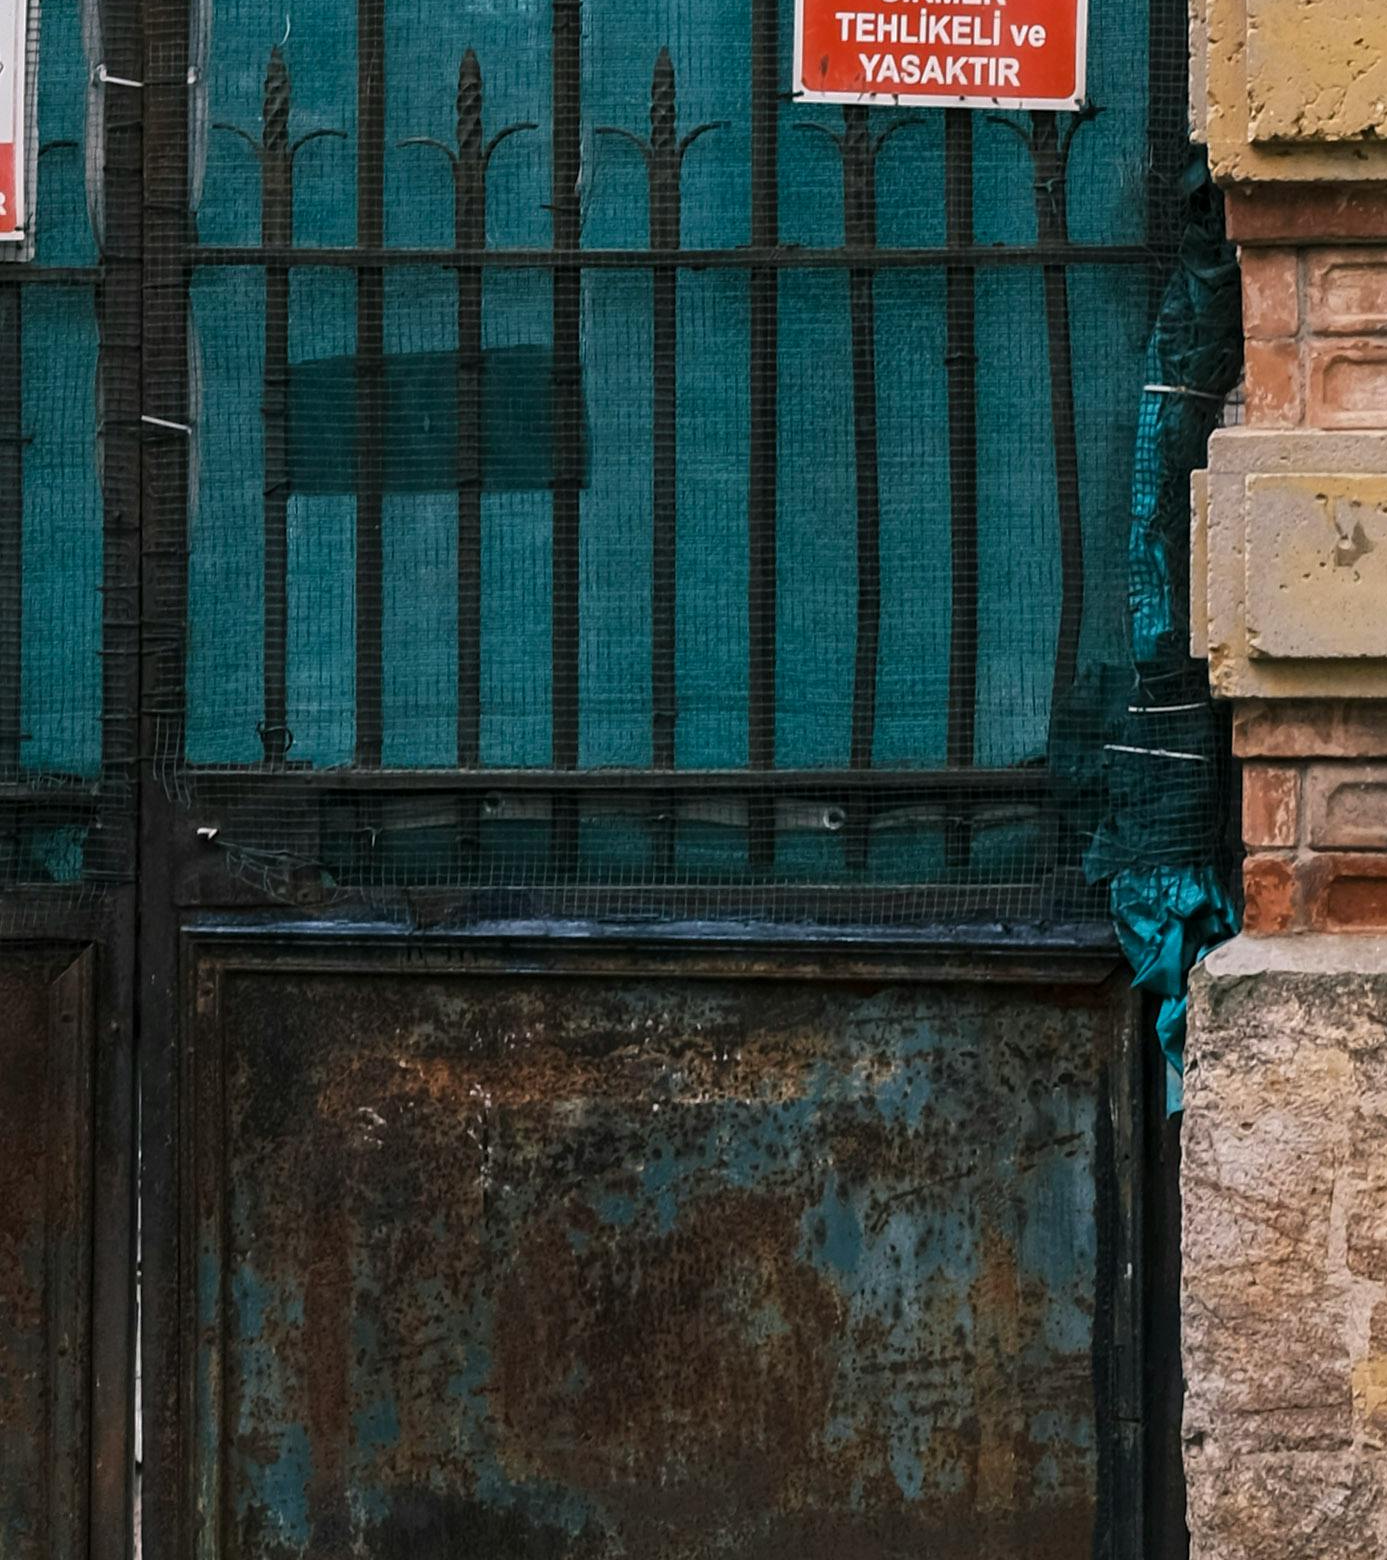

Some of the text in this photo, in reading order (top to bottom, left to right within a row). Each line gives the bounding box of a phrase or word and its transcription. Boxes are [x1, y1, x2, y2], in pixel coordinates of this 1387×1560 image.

[835, 7, 1046, 48] TEHLİKELİ ve
[858, 53, 1021, 87] YASAKTIR
